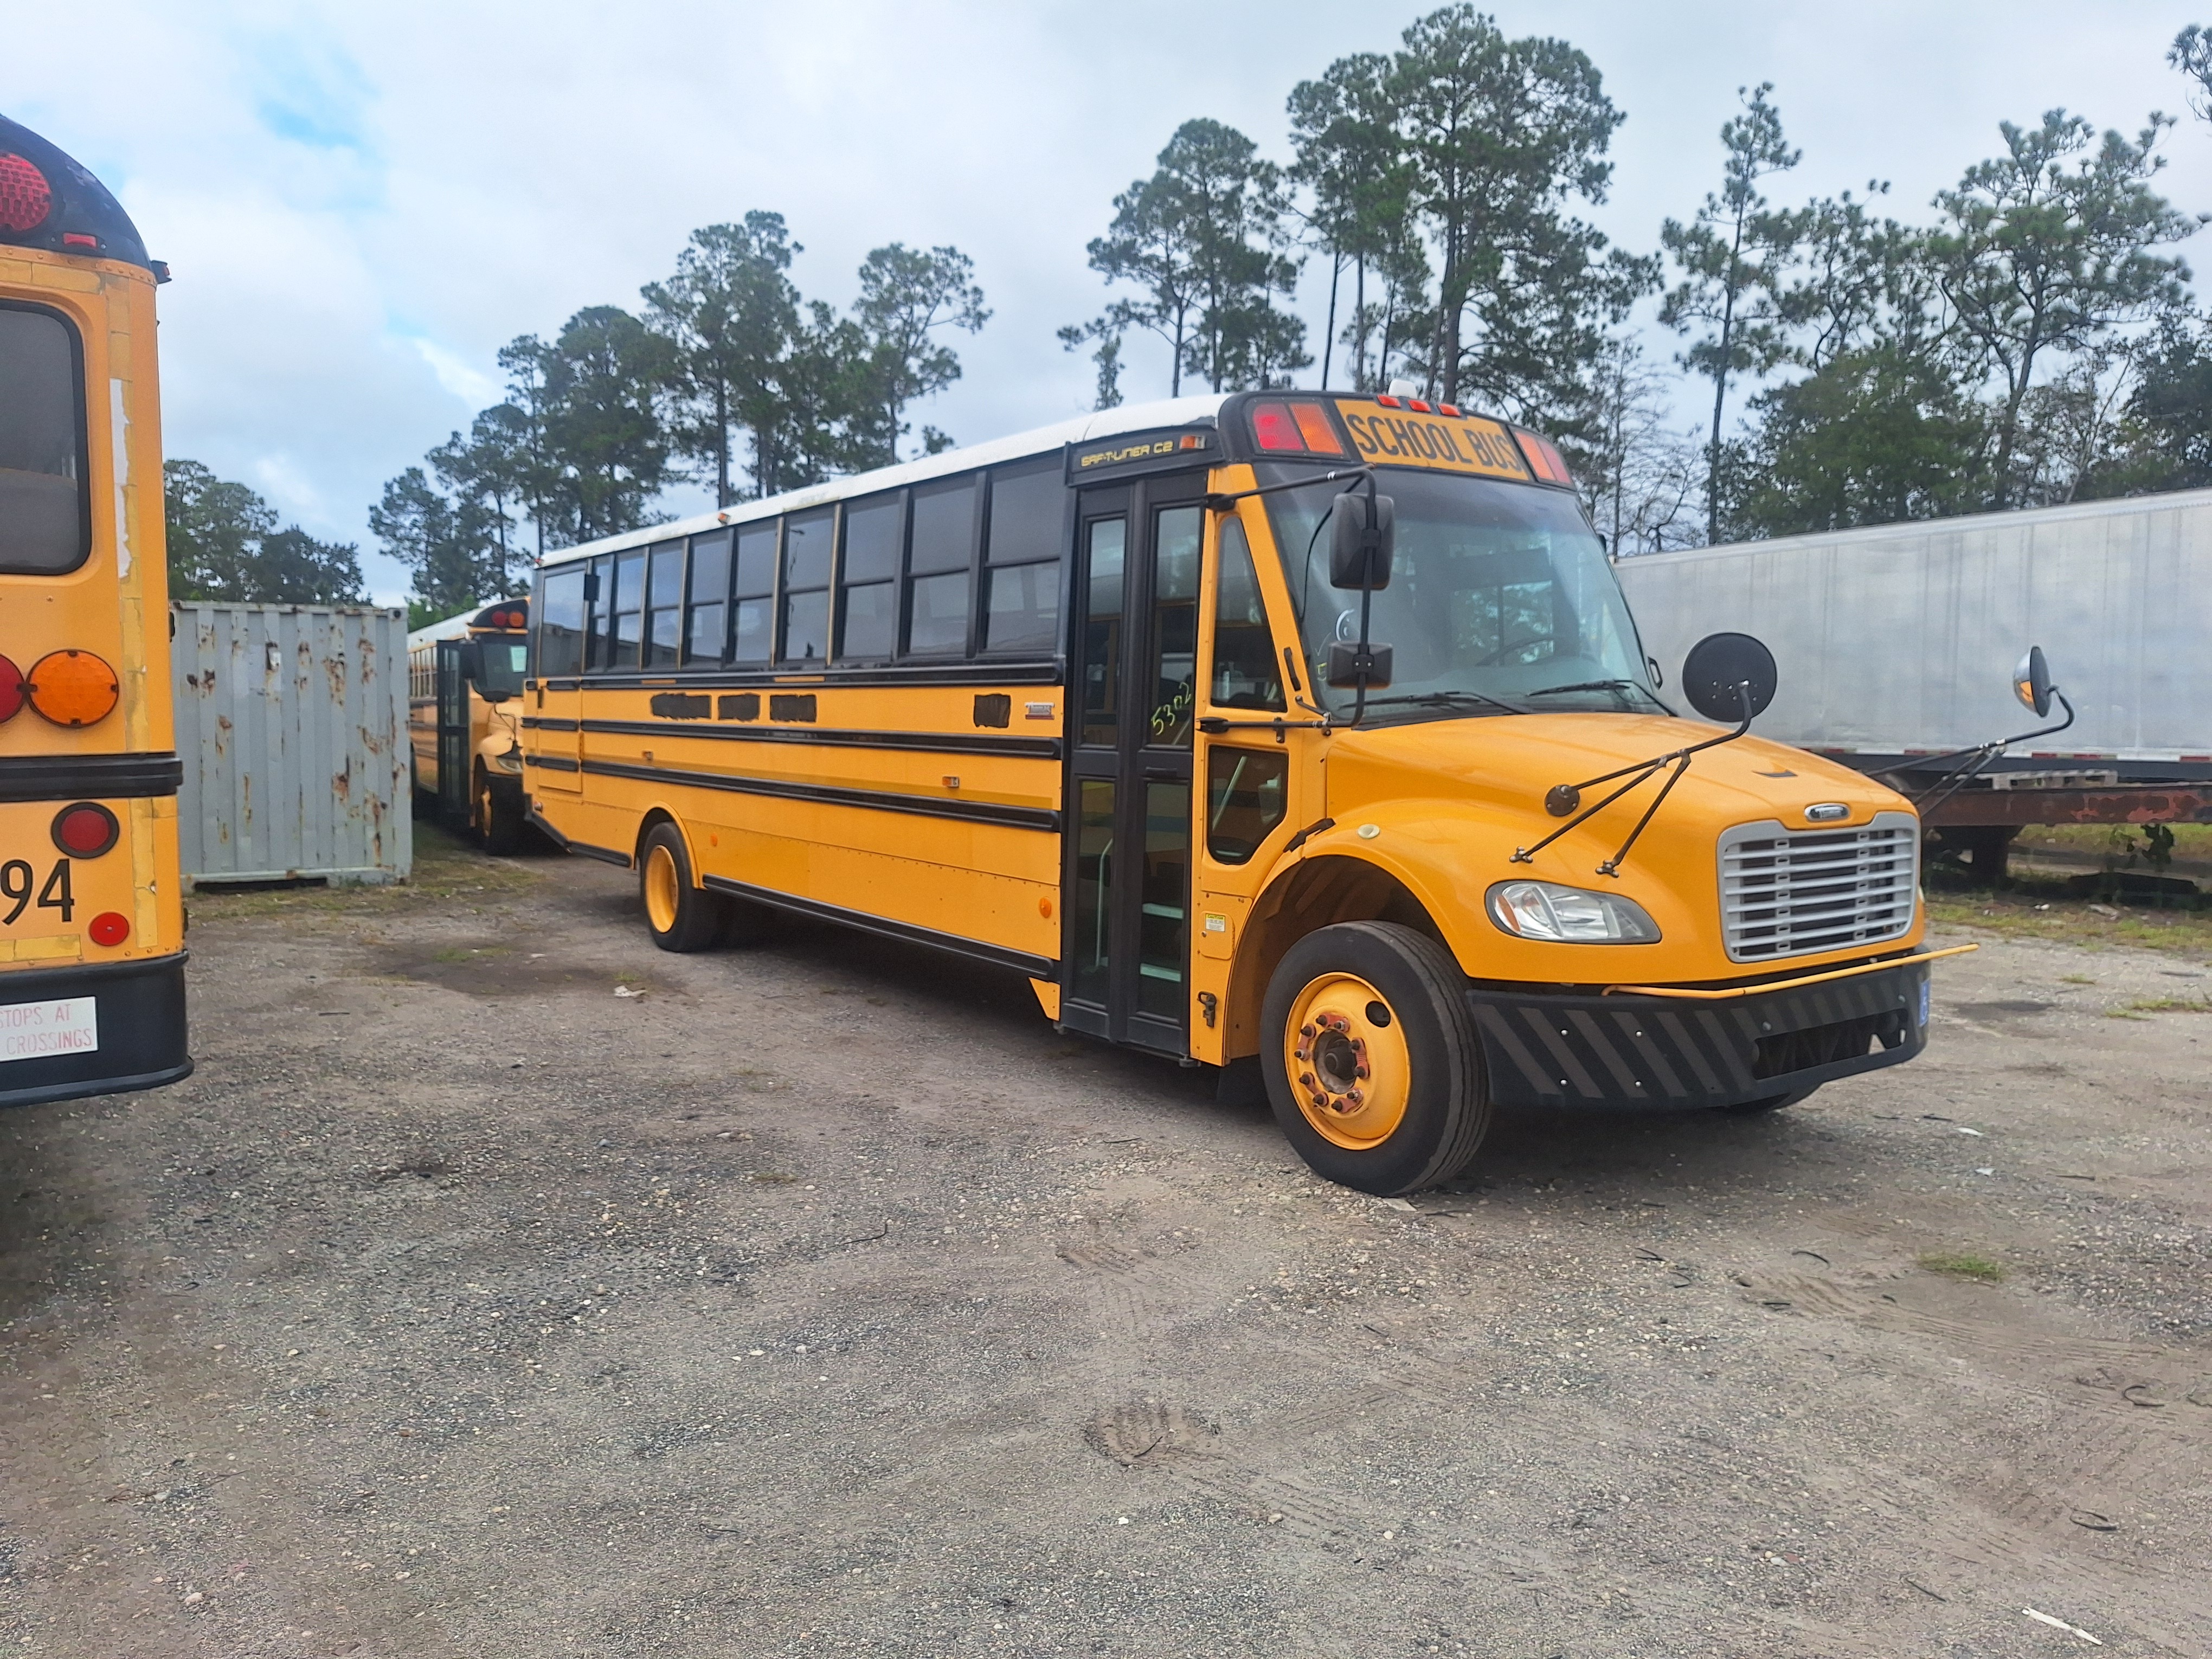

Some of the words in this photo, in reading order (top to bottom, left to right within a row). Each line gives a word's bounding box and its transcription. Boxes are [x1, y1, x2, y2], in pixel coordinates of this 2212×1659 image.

[1153, 440, 1174, 454] C2
[1346, 413, 1473, 464] SCHOOL
[1462, 428, 1522, 472] BUS
[1151, 682, 1191, 735] 5302
[1, 858, 75, 925] 94
[55, 1004, 71, 1023] AT
[7, 1029, 92, 1055] CROSSINGS
